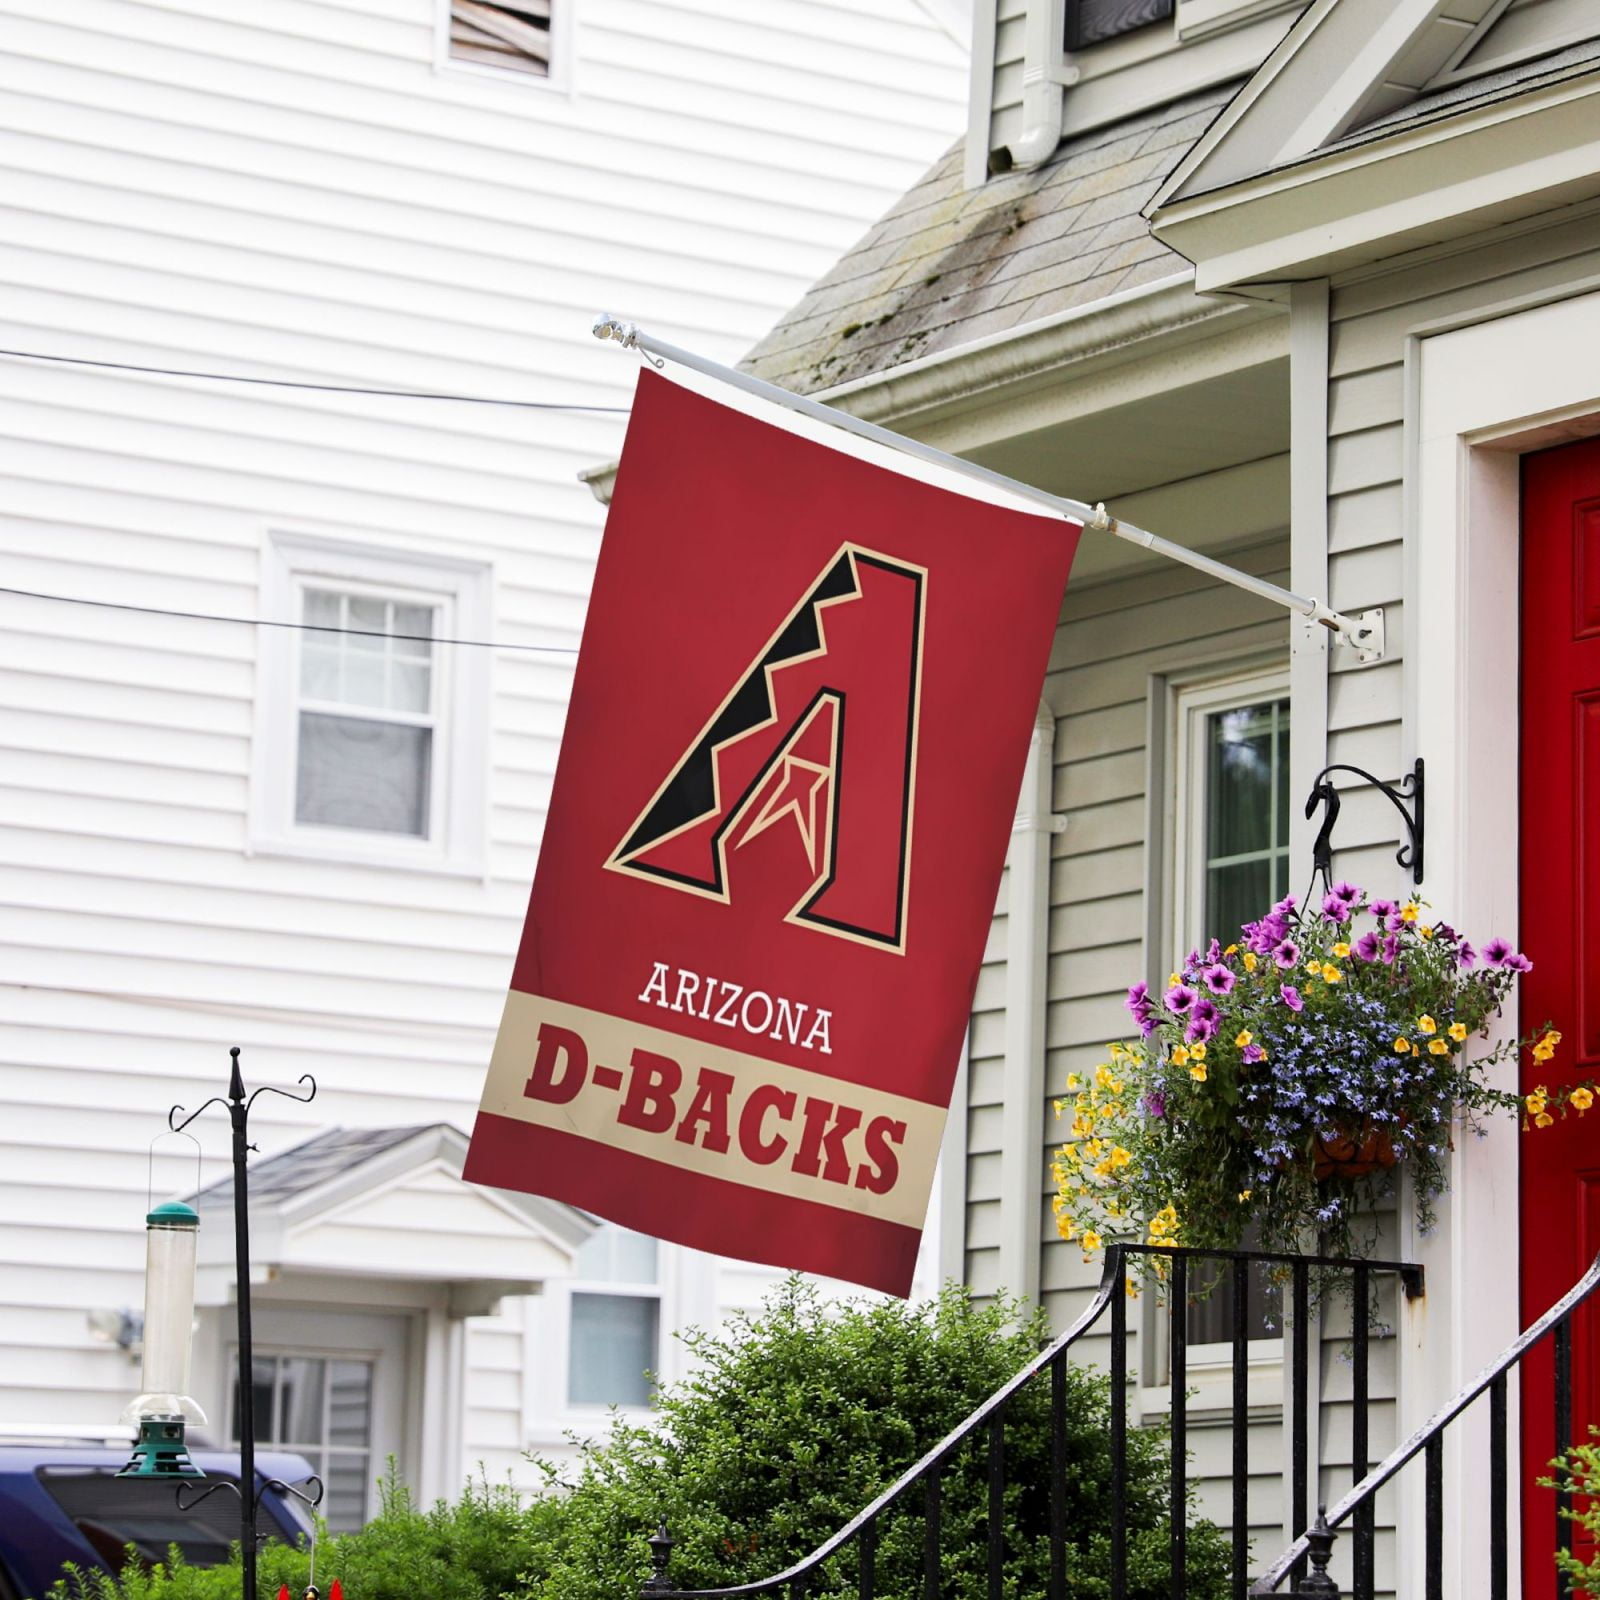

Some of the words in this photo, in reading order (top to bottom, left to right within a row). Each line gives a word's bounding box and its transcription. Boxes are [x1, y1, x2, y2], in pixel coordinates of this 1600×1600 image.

[602, 541, 929, 957] A
[637, 961, 833, 1055] ARIZONA
[523, 1022, 907, 1195] D-BACKS
